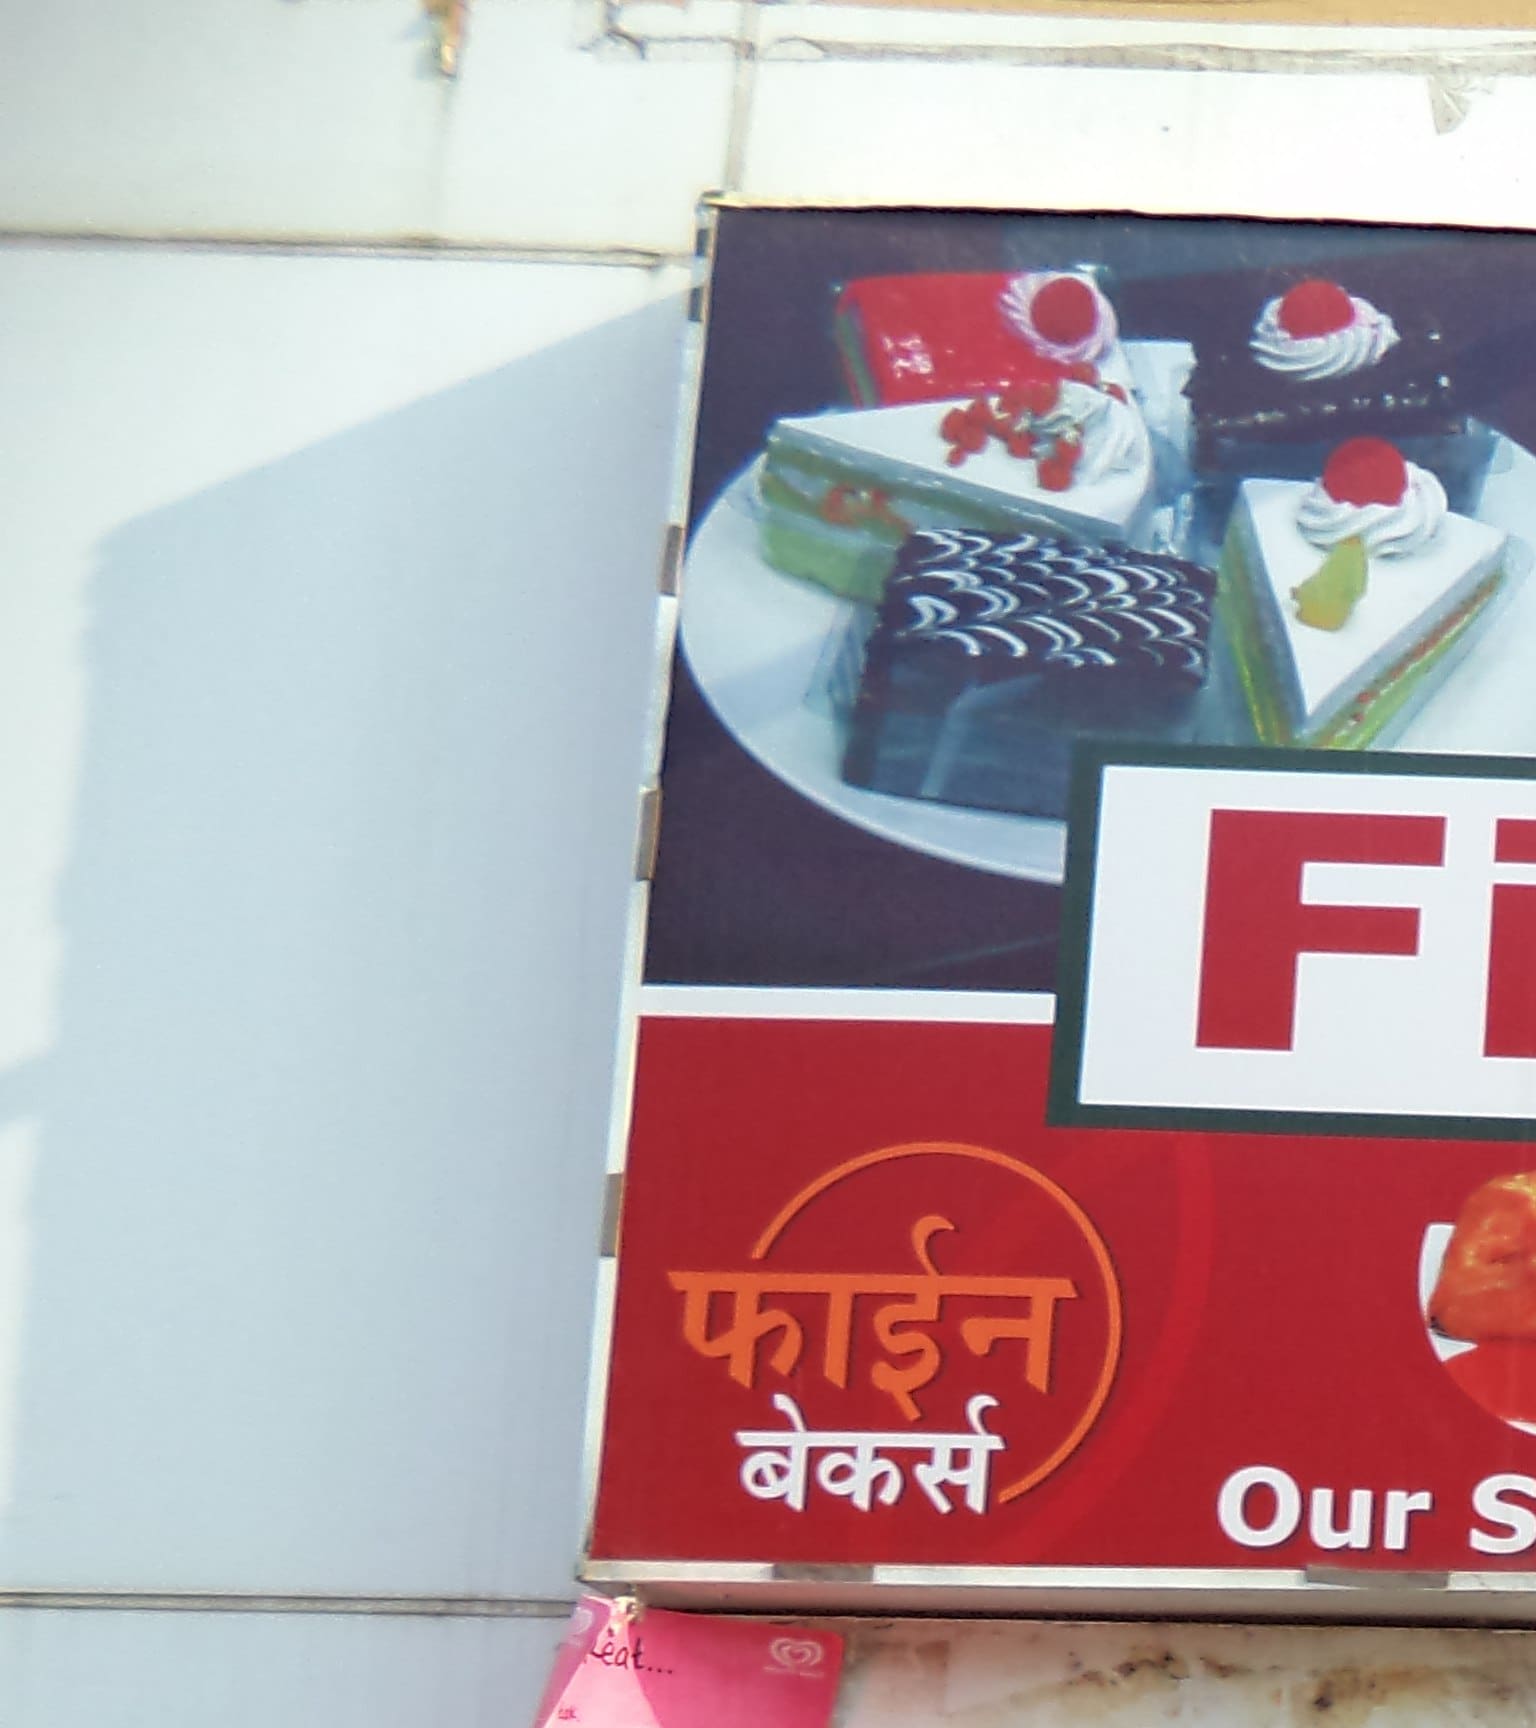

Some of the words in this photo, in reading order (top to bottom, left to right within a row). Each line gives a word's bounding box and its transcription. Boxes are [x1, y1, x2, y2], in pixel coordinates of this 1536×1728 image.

[668, 1213, 1078, 1421] फाईन
[734, 1391, 1006, 1516] बेकर्स
[1216, 1464, 1432, 1551] Our
